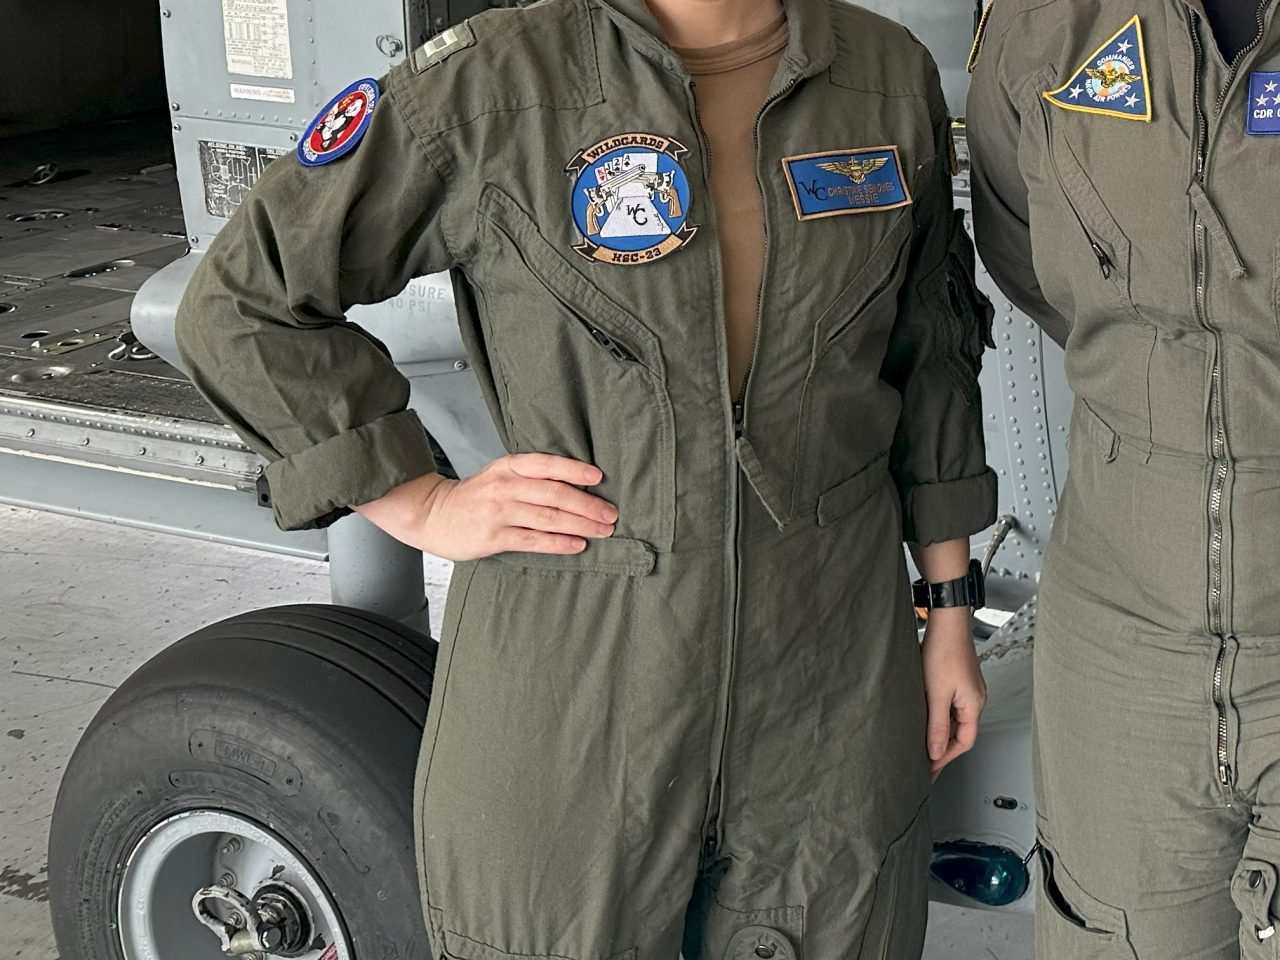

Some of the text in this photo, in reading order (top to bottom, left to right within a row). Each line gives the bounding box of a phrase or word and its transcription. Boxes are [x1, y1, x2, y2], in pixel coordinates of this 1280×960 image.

[1096, 53, 1136, 70] COMMANDER
[1085, 78, 1132, 103] NAVAL AIR FORCES
[1253, 109, 1274, 119] CDR
[586, 136, 665, 159] WILDCARDS
[611, 247, 662, 263] HSC-23
[403, 283, 447, 301] SURE
[408, 299, 432, 314] PSI
